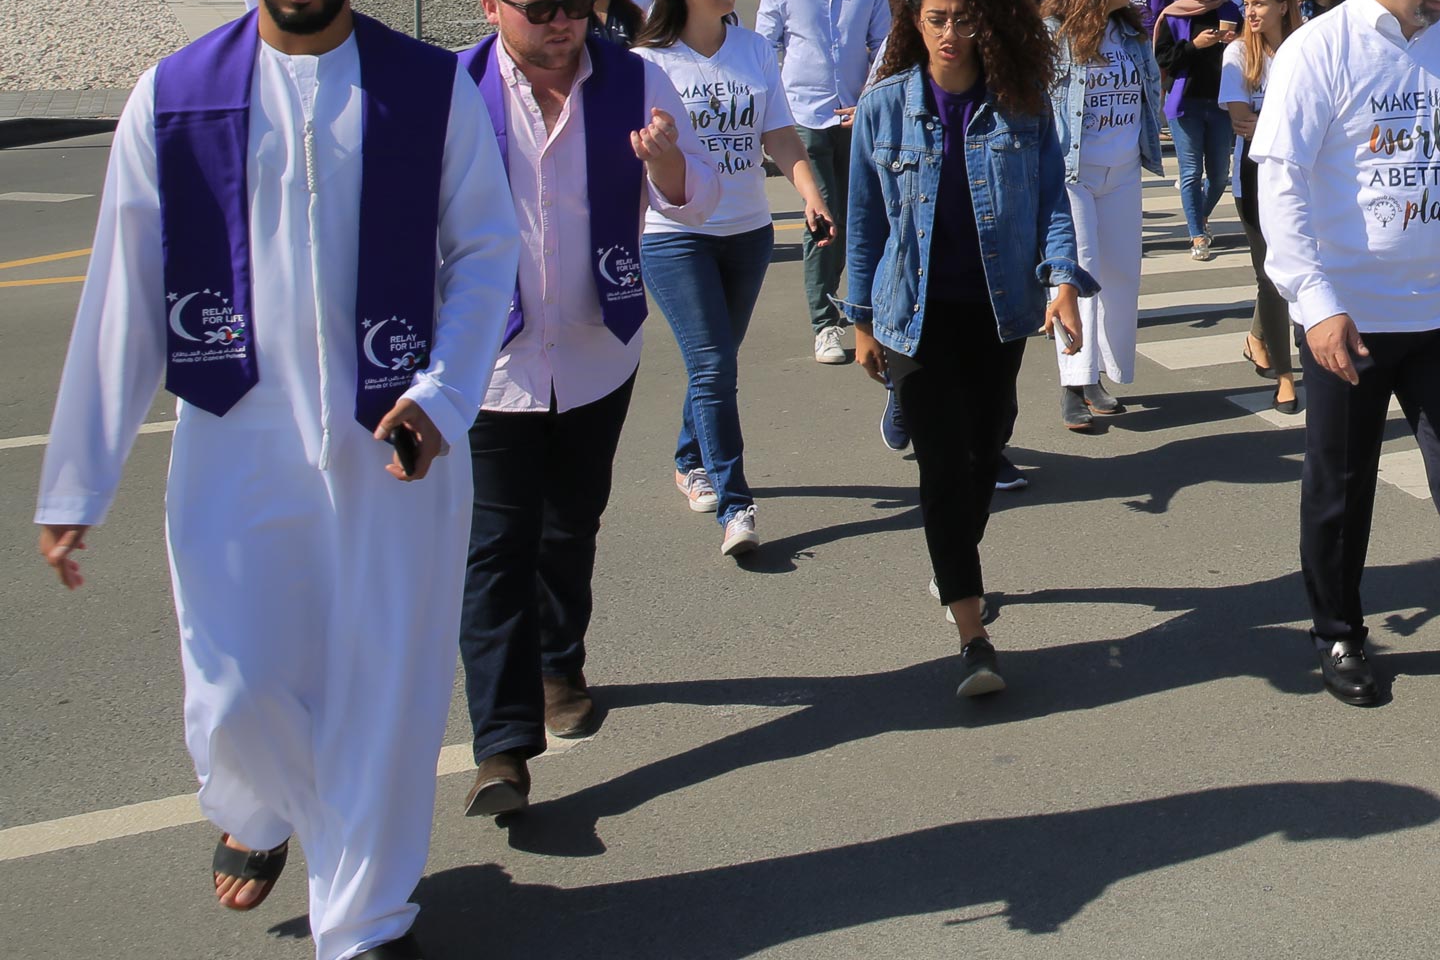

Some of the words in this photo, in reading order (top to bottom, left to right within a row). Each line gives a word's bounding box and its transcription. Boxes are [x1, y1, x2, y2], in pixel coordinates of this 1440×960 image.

[727, 80, 750, 96] this
[1090, 93, 1139, 108] BETTER
[1371, 91, 1427, 114] MAKE
[1369, 167, 1385, 187] A
[202, 306, 234, 317] RELAY
[203, 316, 223, 325] FOR
[225, 314, 244, 323] LIFE
[390, 334, 417, 343] RELAY
[390, 343, 407, 352] FOR
[409, 340, 427, 349] LIFE
